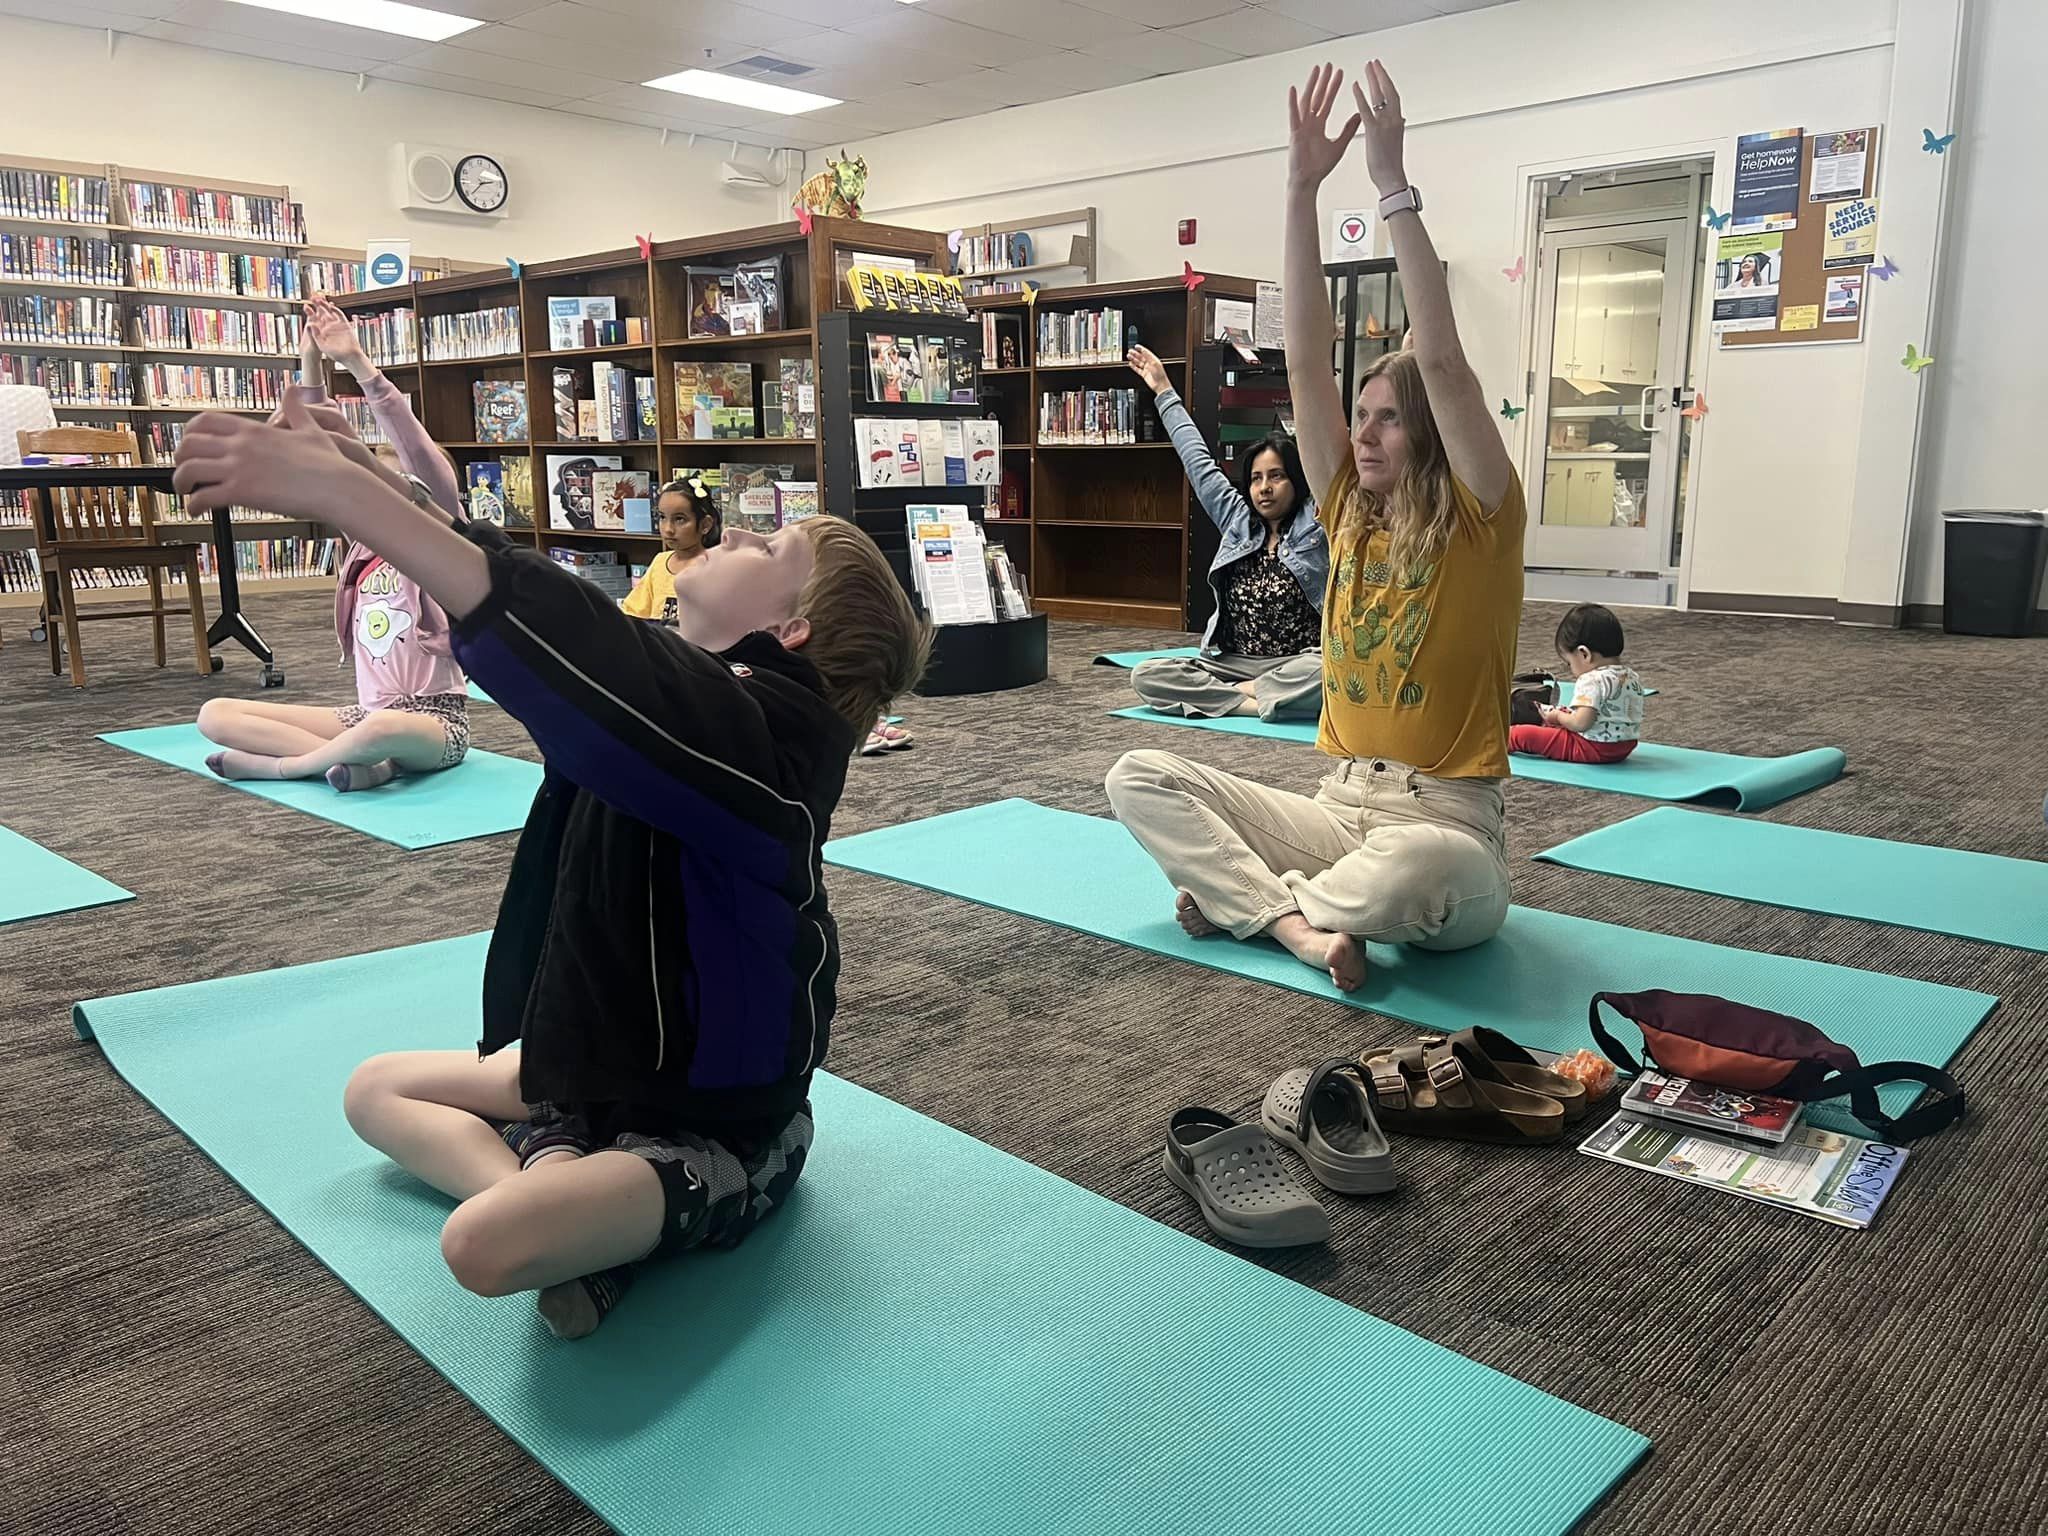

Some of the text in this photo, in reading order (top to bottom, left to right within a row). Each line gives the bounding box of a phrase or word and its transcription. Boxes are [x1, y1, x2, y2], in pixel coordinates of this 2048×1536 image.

[1741, 146, 1797, 160] Get homework
[1740, 155, 1797, 170] HelpNow
[1828, 205, 1876, 231] SERVICE
[1834, 201, 1865, 219] NEED
[1831, 214, 1876, 238] HOURS?
[490, 403, 515, 417] Reef
[1858, 1143, 1898, 1169] Off
[1860, 1164, 1881, 1178] the
